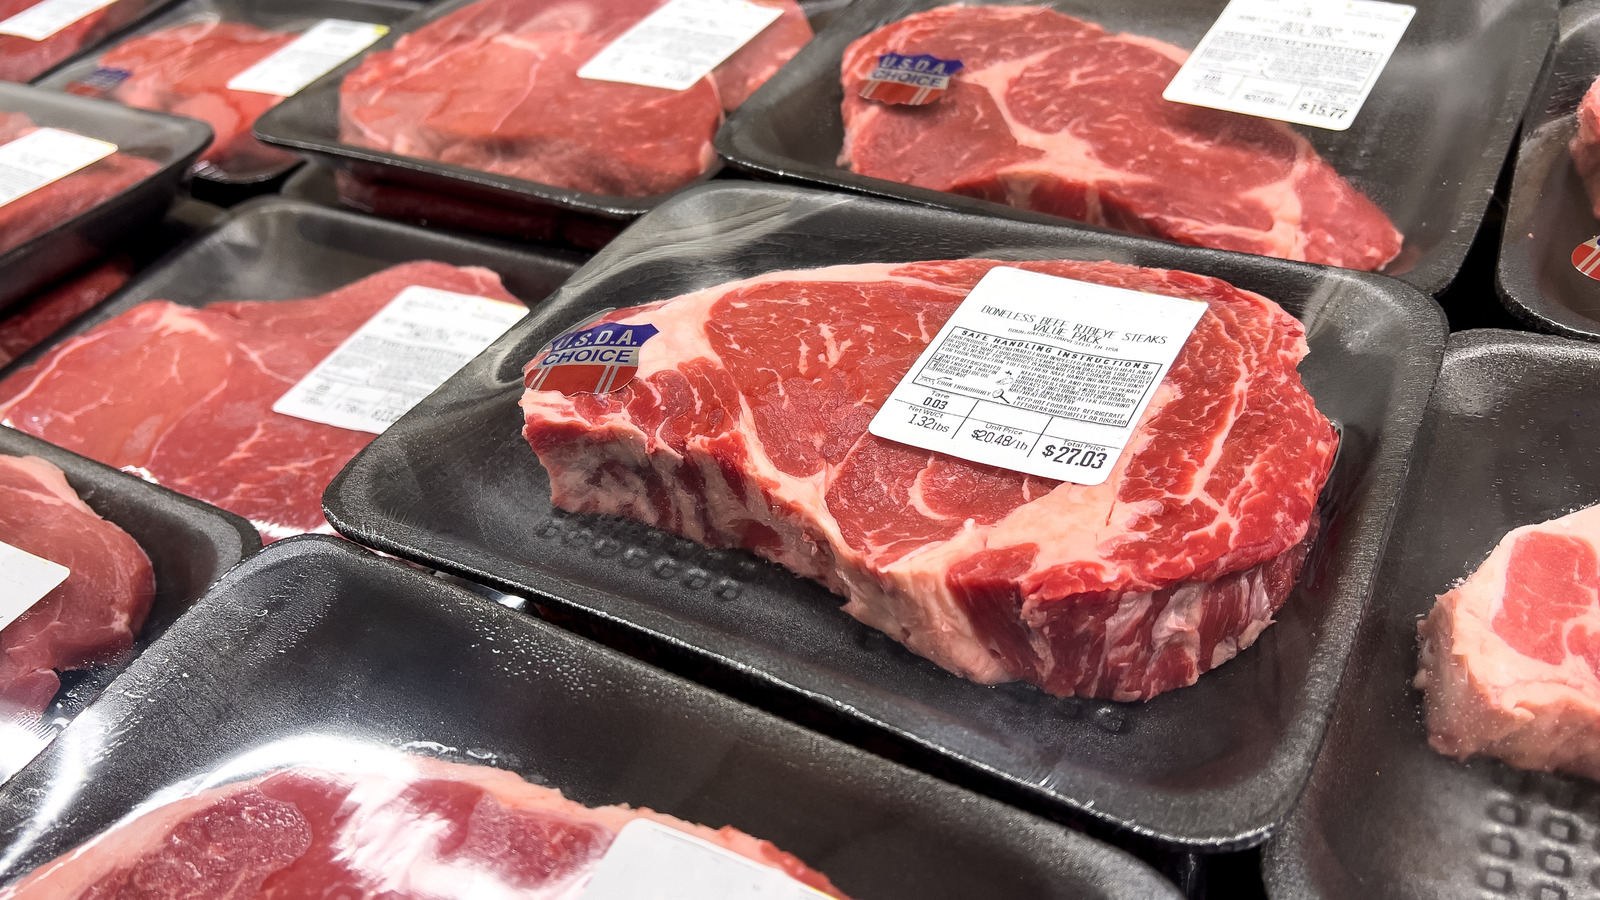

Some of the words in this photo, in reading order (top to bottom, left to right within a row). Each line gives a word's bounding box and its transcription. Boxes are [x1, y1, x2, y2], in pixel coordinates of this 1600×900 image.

[981, 305, 1036, 322] BONELESS
[1039, 316, 1069, 328] BEEF
[1073, 323, 1118, 339] RIBEYE
[1122, 333, 1167, 344] STEAKS
[1032, 323, 1069, 336] VALUE
[1071, 331, 1102, 344] PACK
[555, 329, 638, 350] U.S.D.A.
[542, 349, 633, 366] CHOICE
[961, 330, 989, 341] SAFE
[993, 337, 1052, 353] HANDLING
[1057, 350, 1149, 369] INSTRUCTIONS
[922, 396, 948, 410] 0.03
[932, 390, 949, 399] Tare
[908, 404, 922, 413] Net
[985, 422, 1004, 431] Unit
[1003, 426, 1024, 435] Price
[971, 429, 1028, 450] $20.48/lb
[1063, 439, 1084, 448] Total
[1084, 442, 1107, 451] Price
[1042, 444, 1107, 469] $27.03
